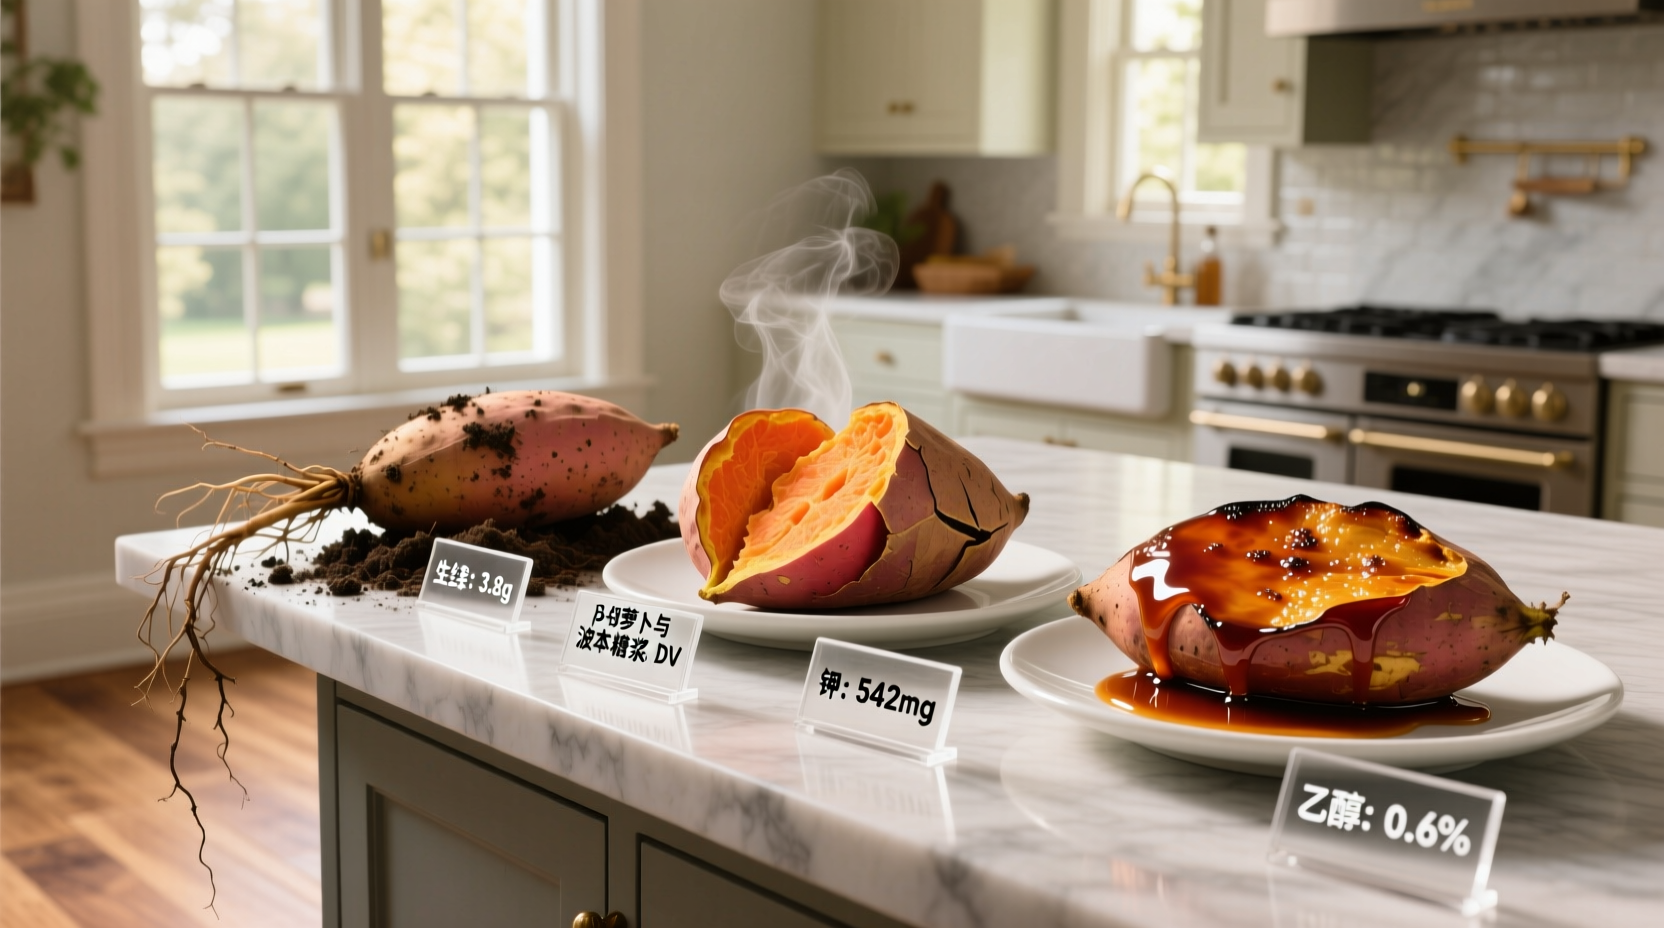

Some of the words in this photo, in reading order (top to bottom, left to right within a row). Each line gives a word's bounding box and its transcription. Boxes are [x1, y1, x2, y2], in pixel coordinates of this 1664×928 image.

[478, 571, 513, 604] 3.8g
[653, 642, 682, 667] DV
[819, 667, 849, 700] 钾:
[855, 677, 936, 727] 542mg
[1297, 783, 1374, 831] 乙醇:
[1383, 803, 1471, 856] 0.6%
